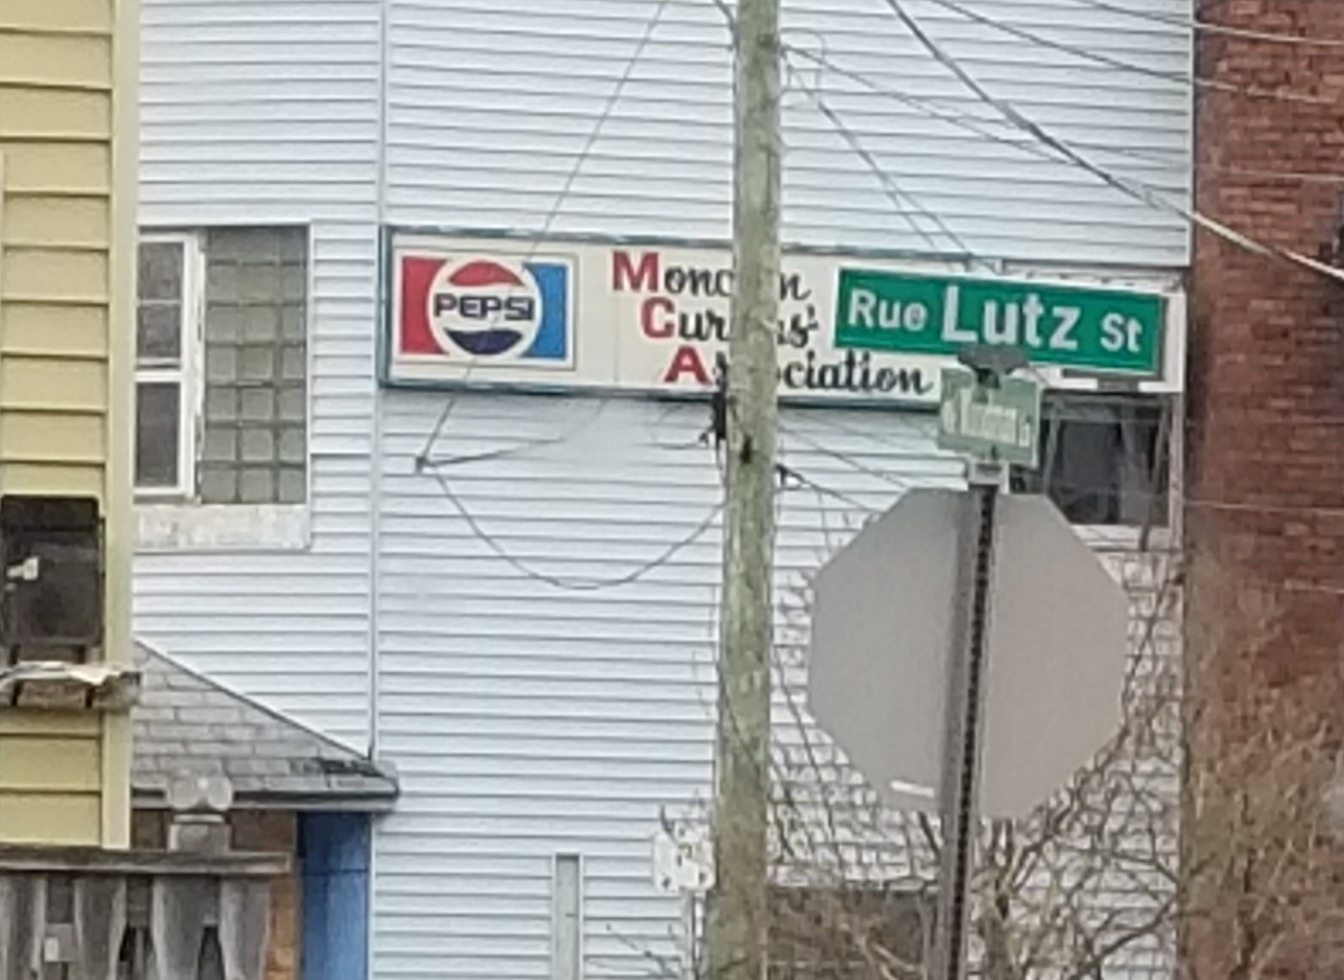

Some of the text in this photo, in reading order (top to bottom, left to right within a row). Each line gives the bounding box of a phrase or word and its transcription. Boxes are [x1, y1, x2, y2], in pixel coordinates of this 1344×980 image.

[612, 250, 811, 302] Moncn
[433, 292, 535, 321] PEPSI
[848, 285, 1144, 352] Rue Lutz St
[664, 345, 934, 394] Asciation
